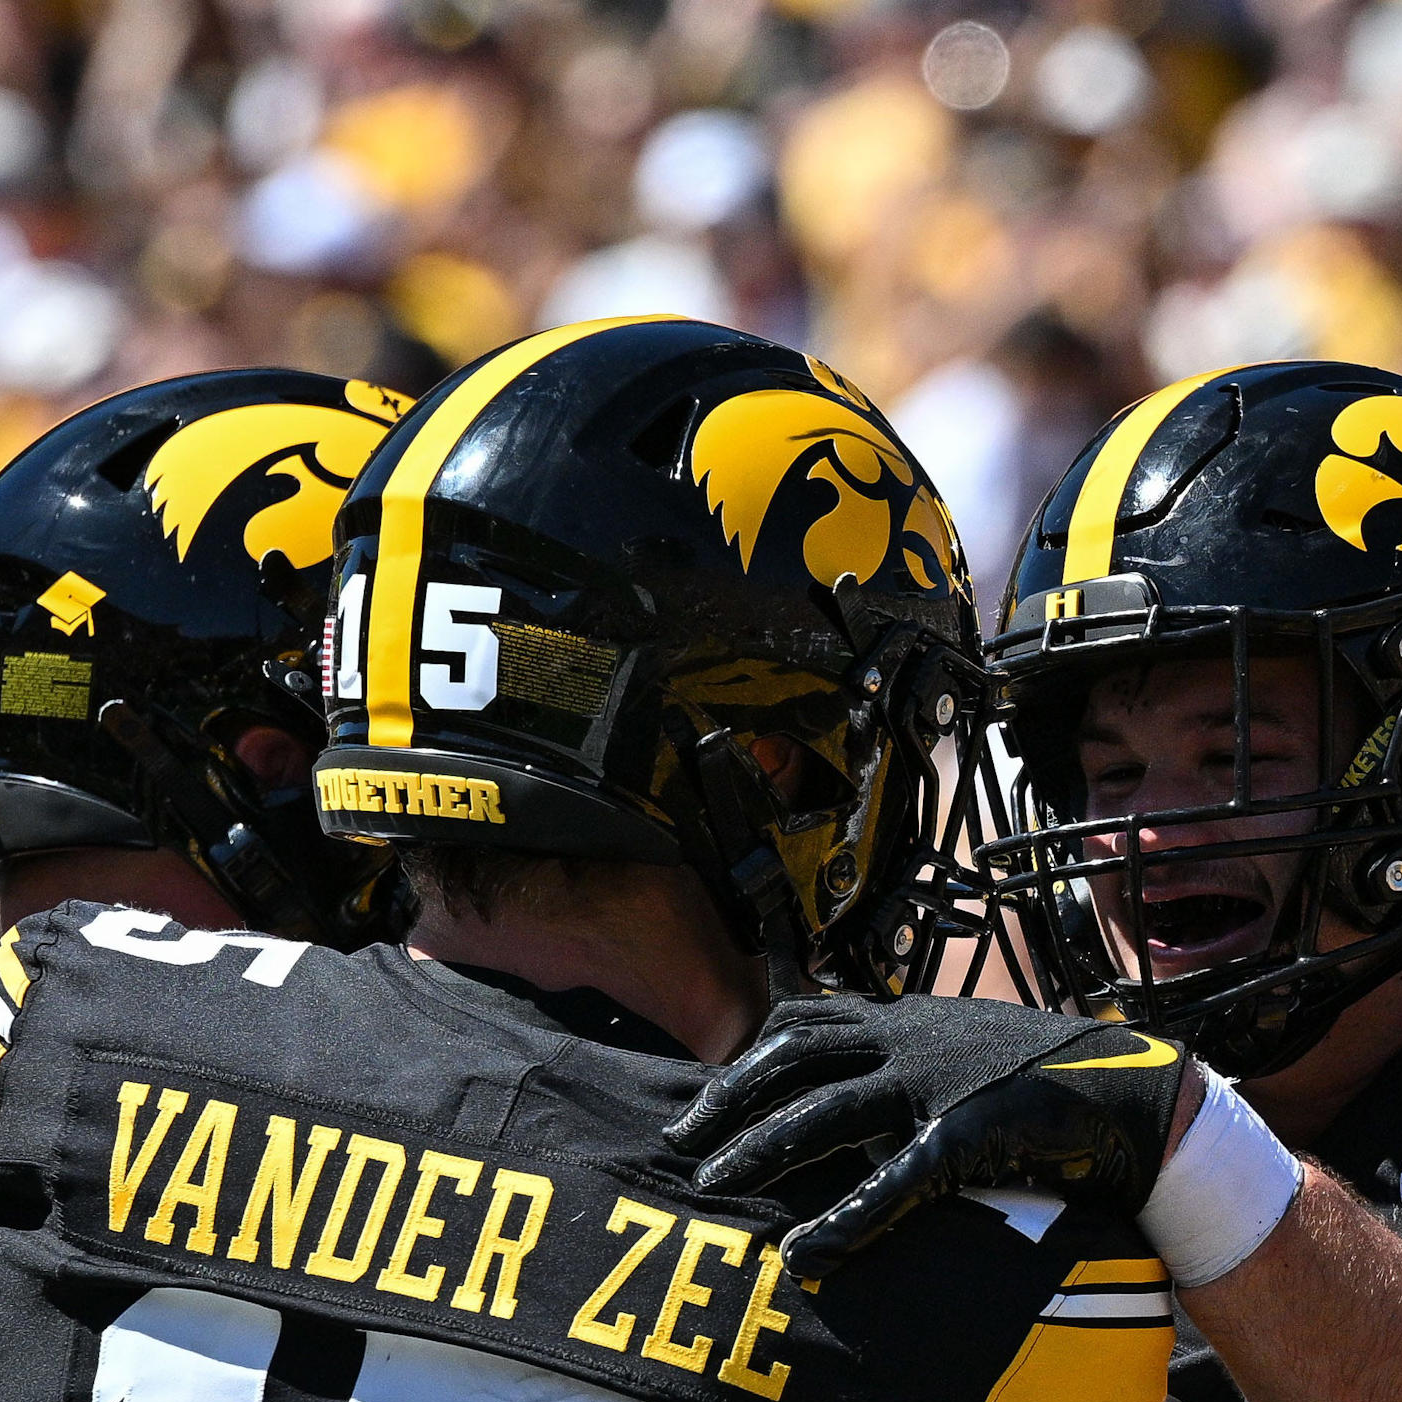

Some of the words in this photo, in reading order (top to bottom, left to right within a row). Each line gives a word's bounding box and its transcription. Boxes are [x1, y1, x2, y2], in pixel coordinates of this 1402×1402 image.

[523, 623, 589, 644] WARNING
[316, 768, 506, 824] TOGETHER
[108, 1081, 554, 1320] VANDER
[567, 1196, 821, 1402] ZEE
